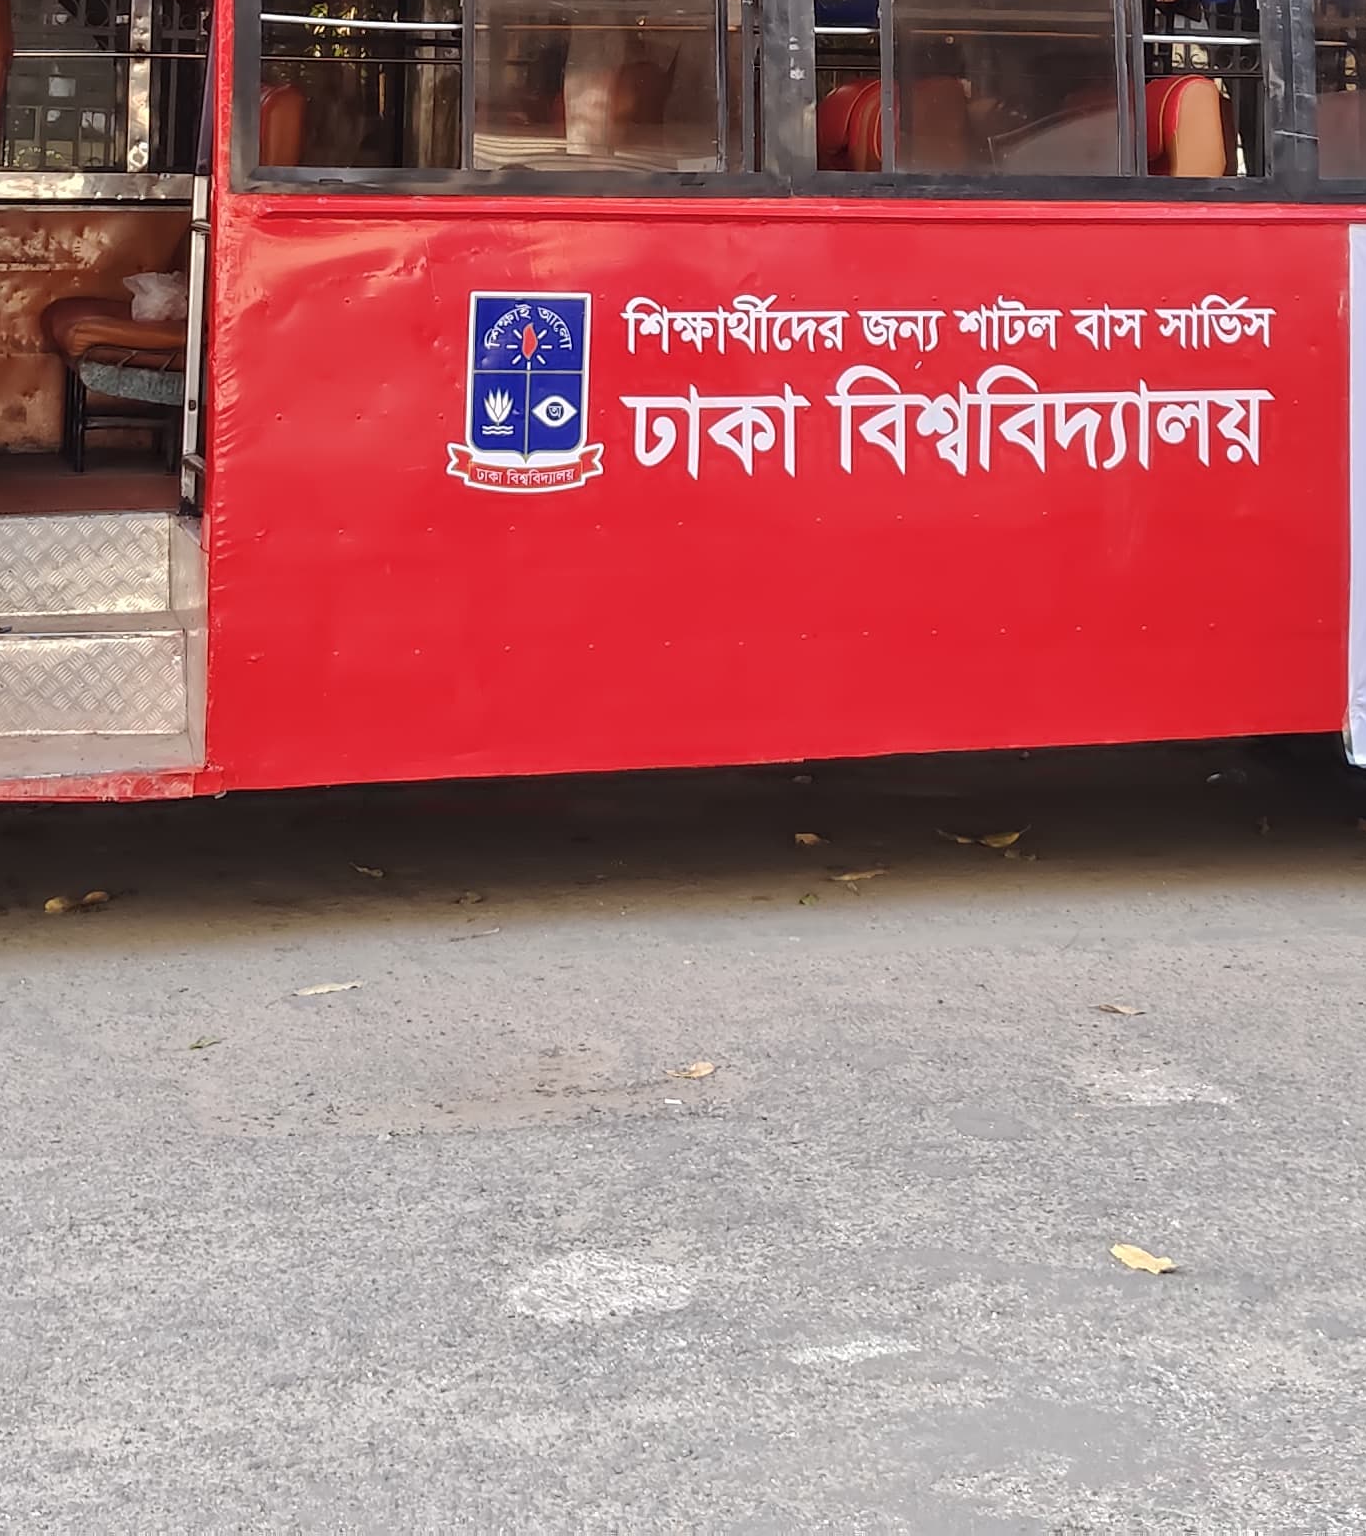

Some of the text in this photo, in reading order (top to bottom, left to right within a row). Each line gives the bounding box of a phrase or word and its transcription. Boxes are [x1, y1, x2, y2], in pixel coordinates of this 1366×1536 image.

[620, 294, 1276, 355] শিক্ষার্থীদের জন্য শাটল বাস সার্ভিস
[619, 365, 1276, 479] ঢাকা বিশ্ববিদ্যালয়
[476, 468, 502, 484] ঢাকা
